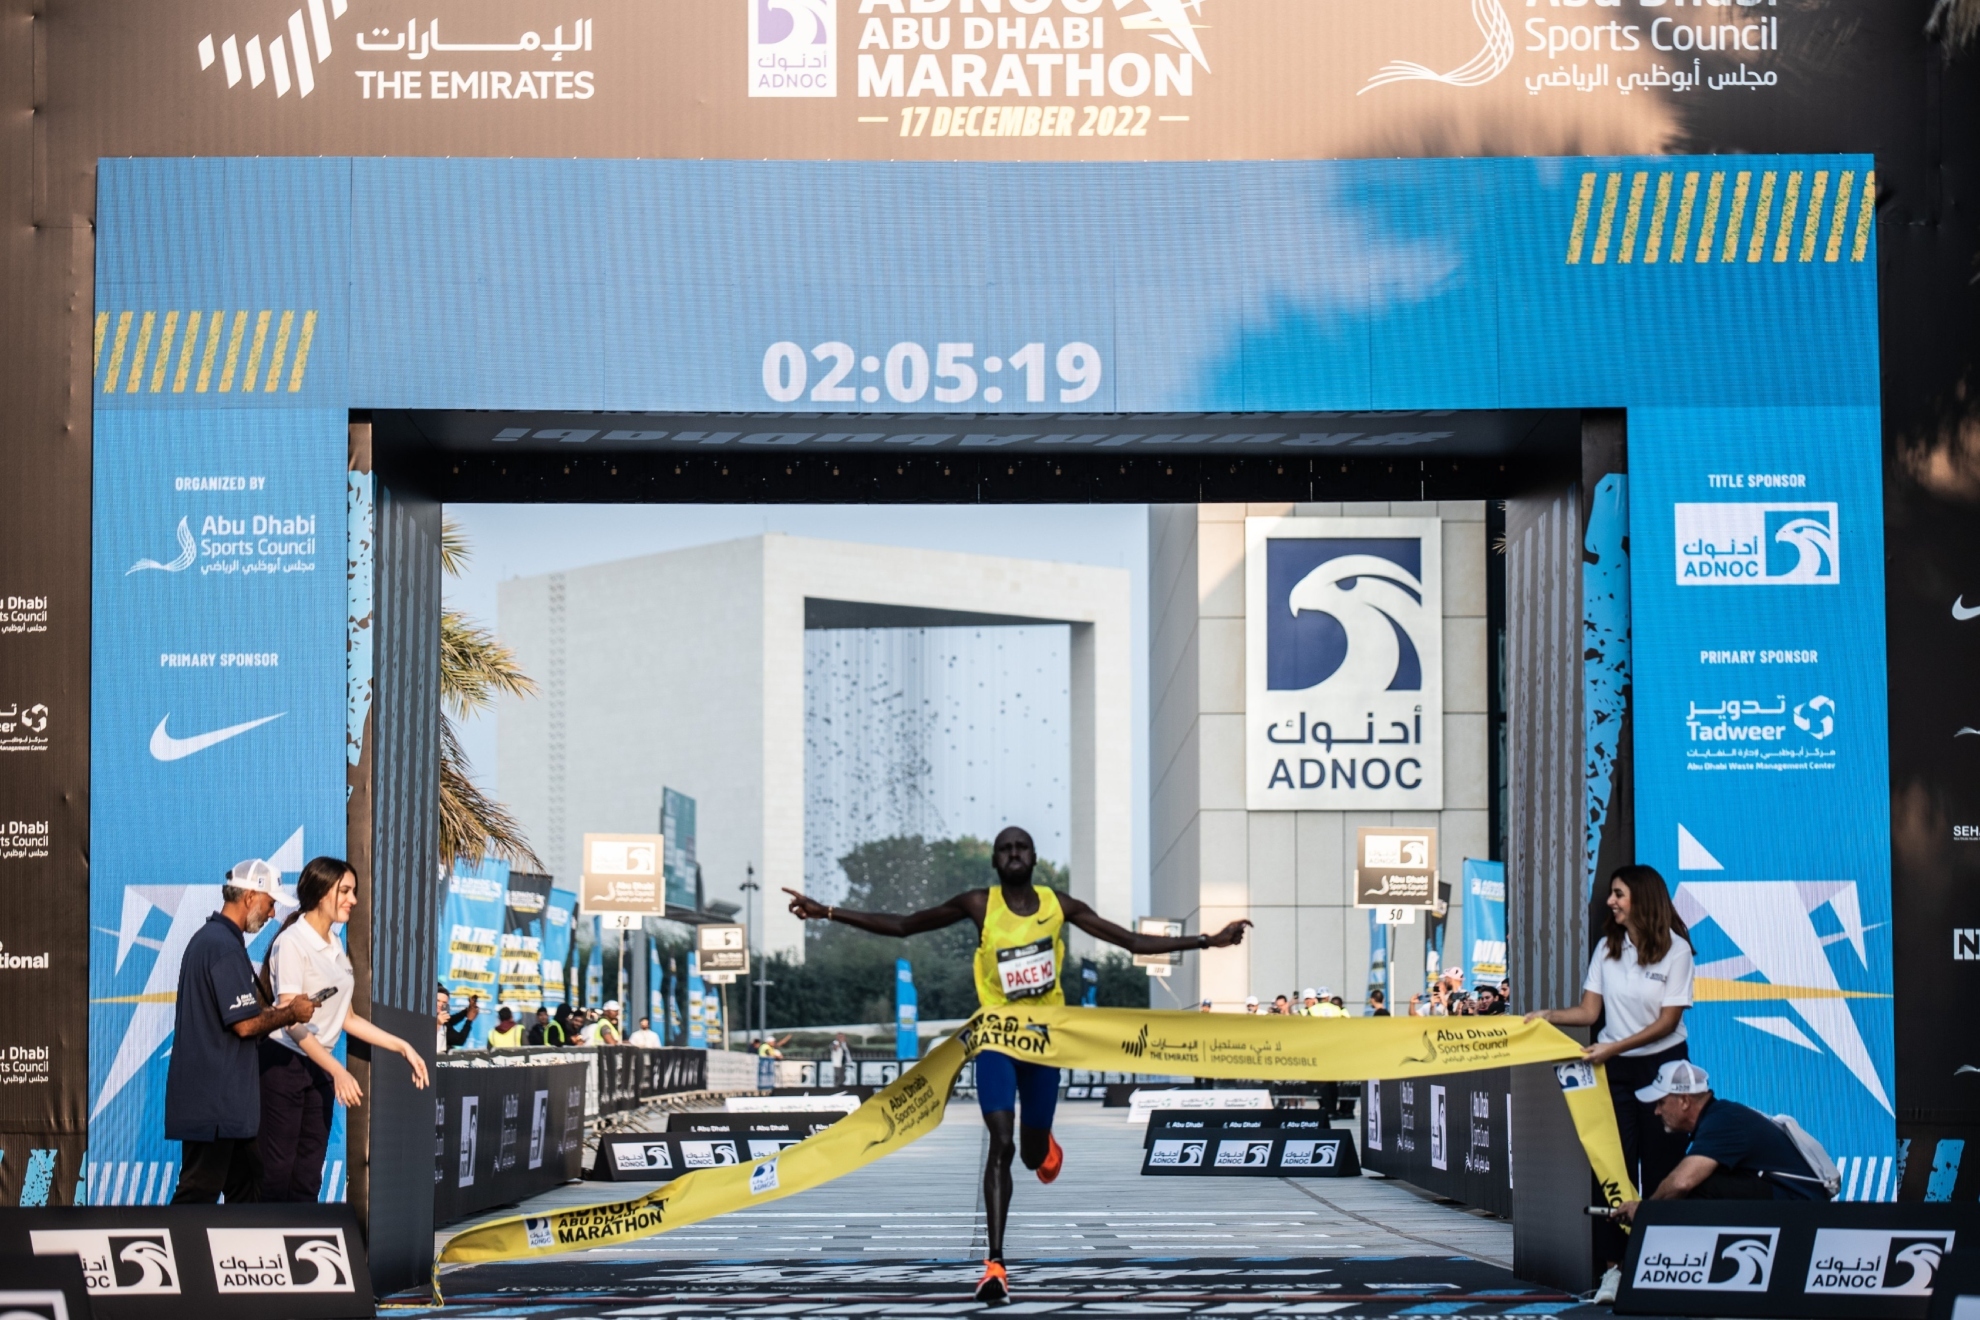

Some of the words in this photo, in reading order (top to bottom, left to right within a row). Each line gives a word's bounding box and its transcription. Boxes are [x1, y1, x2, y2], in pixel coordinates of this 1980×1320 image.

[356, 18, 592, 61] الإمارات
[858, 17, 952, 50] ABU
[964, 17, 1104, 49] DHABI
[1525, 17, 1640, 59] Sports
[1651, 16, 1778, 51] Council
[758, 51, 827, 71] أدنوك
[758, 74, 827, 88] ADNOC
[858, 52, 1193, 97] MARATHON
[1525, 63, 1609, 95] الرياضي
[1616, 58, 1700, 95] أبوظبي
[1707, 63, 1778, 91] مجلس
[355, 70, 422, 99] THE
[430, 70, 595, 99] EMIRATES
[899, 106, 932, 137] 17
[931, 106, 1076, 137] DECEMBER
[1078, 105, 1152, 137] 2022
[761, 341, 1102, 404] 02:05:19
[175, 476, 246, 491] ORGANIZED
[249, 476, 266, 490] BY
[1708, 474, 1744, 488] TITLE
[1748, 474, 1806, 488] SPONSOR
[201, 515, 245, 535] Abu
[252, 515, 316, 535] Dhabi
[201, 539, 253, 559] Sports
[257, 538, 316, 556] Council
[1683, 536, 1758, 559] أدنوك
[201, 560, 239, 575] الرياضي
[242, 558, 281, 575] أبوظبي
[283, 561, 316, 573] مجلس
[1684, 560, 1759, 578] ADNOC
[8, 596, 47, 610] Dhabi
[11, 611, 47, 622] Council
[160, 653, 216, 667] PRIMARY
[220, 653, 279, 667] SPONSOR
[1700, 650, 1755, 664] PRIMARY
[1760, 650, 1818, 664] SPONSOR
[1686, 695, 1786, 721] تدوير
[1267, 705, 1422, 753] أدنوك
[1686, 721, 1786, 741] Tadweer
[1267, 758, 1422, 790] ADNOC
[1687, 762, 1703, 771] Abu
[1704, 762, 1727, 771] Dhabi
[1756, 762, 1808, 771] Management
[1809, 762, 1836, 770] Center
[9, 821, 49, 834] Dhabi
[1953, 825, 1980, 837] SEH
[13, 835, 49, 847] Council
[616, 915, 630, 928] 50
[1389, 908, 1403, 920] 50
[1006, 966, 1039, 988] PACE
[1437, 1029, 1463, 1041] Abu
[1466, 1028, 1507, 1039] Dhabi
[9, 1046, 49, 1060] Dhabi
[1437, 1043, 1470, 1056] Sports
[1472, 1038, 1509, 1051] Council
[1150, 1052, 1163, 1060] THE
[1164, 1052, 1199, 1062] EMIRATES
[1210, 1054, 1262, 1066] IMPOSSIBLE
[1264, 1056, 1273, 1066] IS
[1275, 1056, 1317, 1067] POSSIBLE
[12, 1061, 49, 1072] Council
[889, 1093, 907, 1112] Abu
[894, 1104, 916, 1124] Sports
[558, 1216, 590, 1228] ABU
[558, 1210, 663, 1244] MARATHON
[530, 1238, 552, 1247] ADNOC
[219, 1254, 283, 1272] أدنوك
[1644, 1252, 1708, 1269] أدنوك
[1816, 1255, 1880, 1273] أدنوك
[224, 1274, 287, 1287] ADNOC
[1641, 1271, 1704, 1284] ADNOC
[1812, 1275, 1877, 1288] ADNOC
